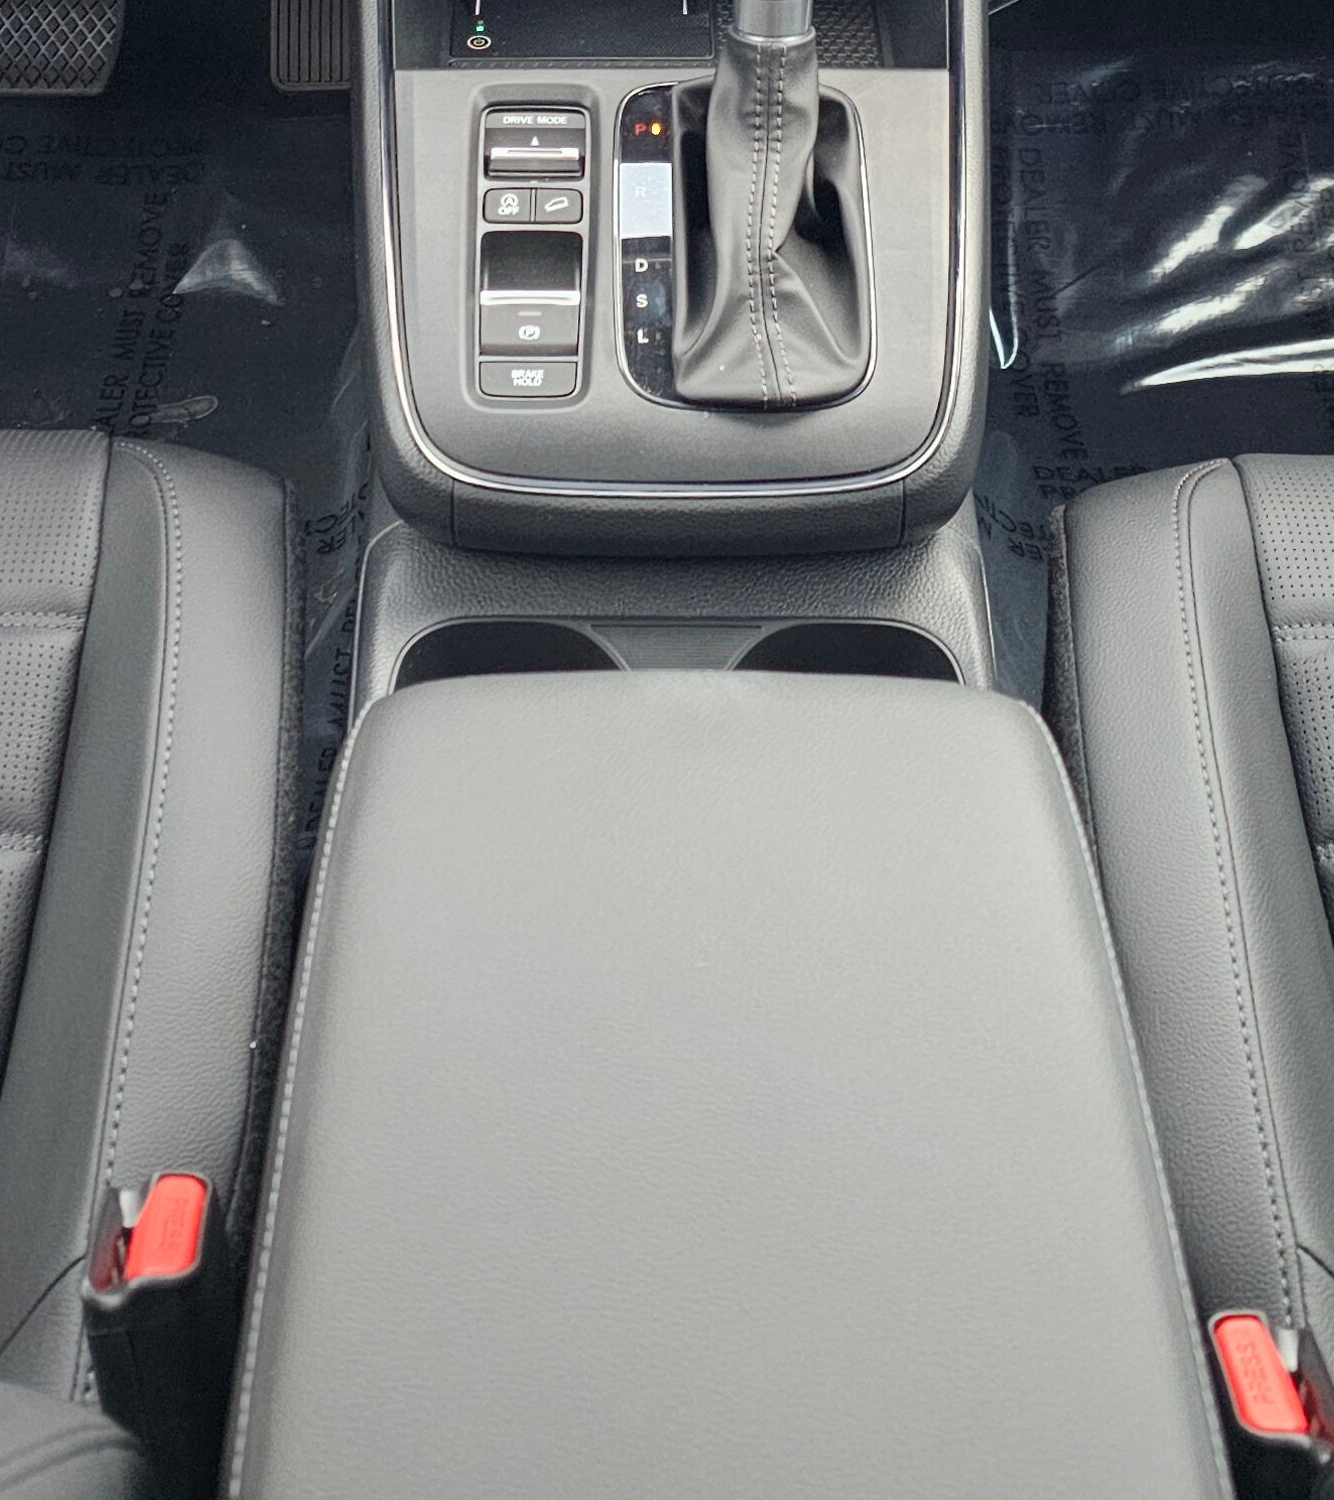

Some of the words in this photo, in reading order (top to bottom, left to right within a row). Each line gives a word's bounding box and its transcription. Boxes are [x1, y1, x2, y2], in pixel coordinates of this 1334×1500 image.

[502, 114, 533, 125] DRIVE
[537, 114, 568, 125] MODE
[635, 124, 646, 135] P
[635, 186, 647, 198] R
[1018, 146, 1051, 253] DEALER
[498, 206, 519, 216] OFF
[126, 192, 168, 300] REMOVE
[635, 258, 648, 272] D
[636, 294, 648, 308] S
[1031, 270, 1064, 343] MUST
[113, 309, 147, 362] MUST
[637, 330, 649, 344] L
[511, 370, 544, 379] BRAKE
[513, 376, 542, 387] HOLD
[1042, 362, 1091, 463] REMOVE
